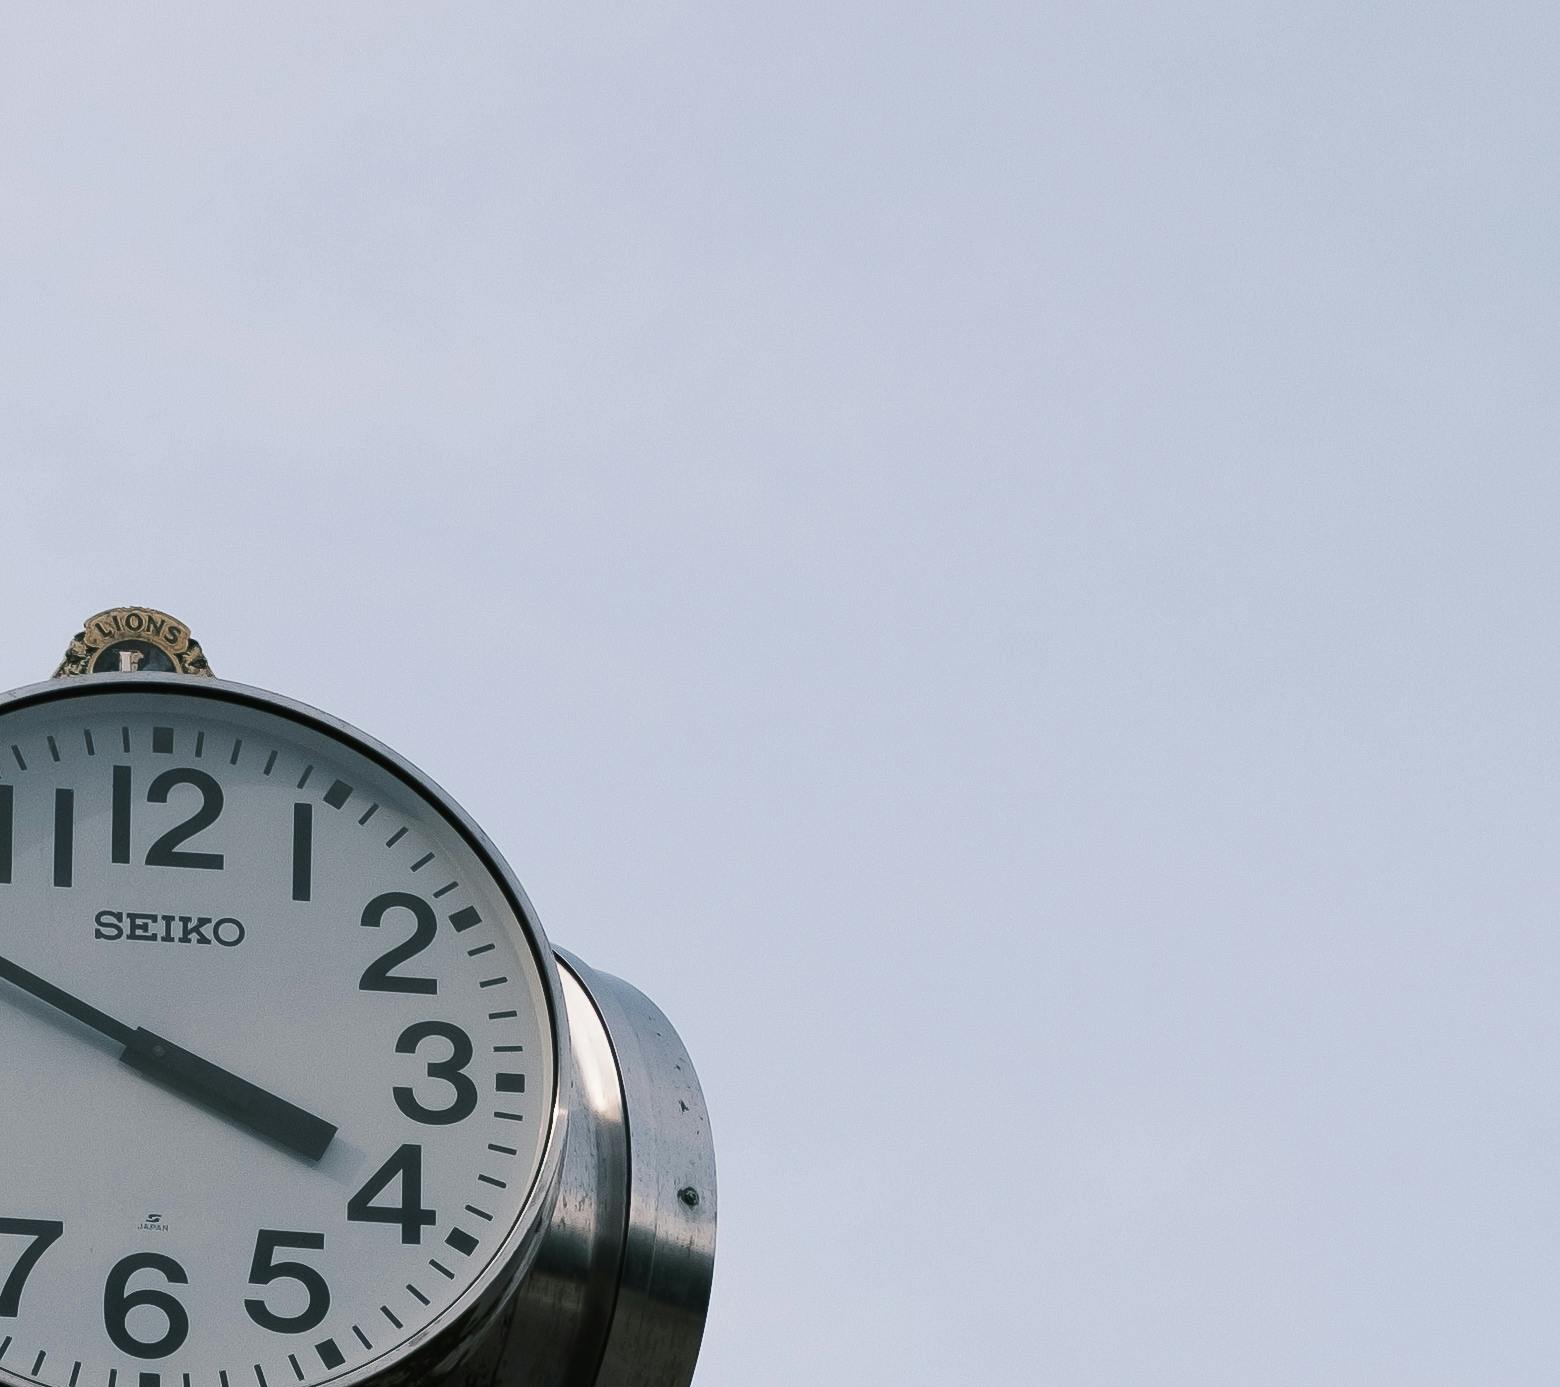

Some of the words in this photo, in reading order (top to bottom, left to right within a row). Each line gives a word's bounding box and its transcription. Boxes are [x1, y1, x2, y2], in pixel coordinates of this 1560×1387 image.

[95, 612, 181, 644] LIONS
[111, 765, 225, 870] 12
[292, 803, 313, 901] 1
[94, 910, 246, 948] SEIKO
[359, 892, 438, 996] 2
[392, 1020, 479, 1126] 3
[137, 1223, 169, 1232] JAPAN
[346, 1143, 437, 1245] 4
[102, 1251, 190, 1359] 6
[243, 1228, 332, 1335] 5
